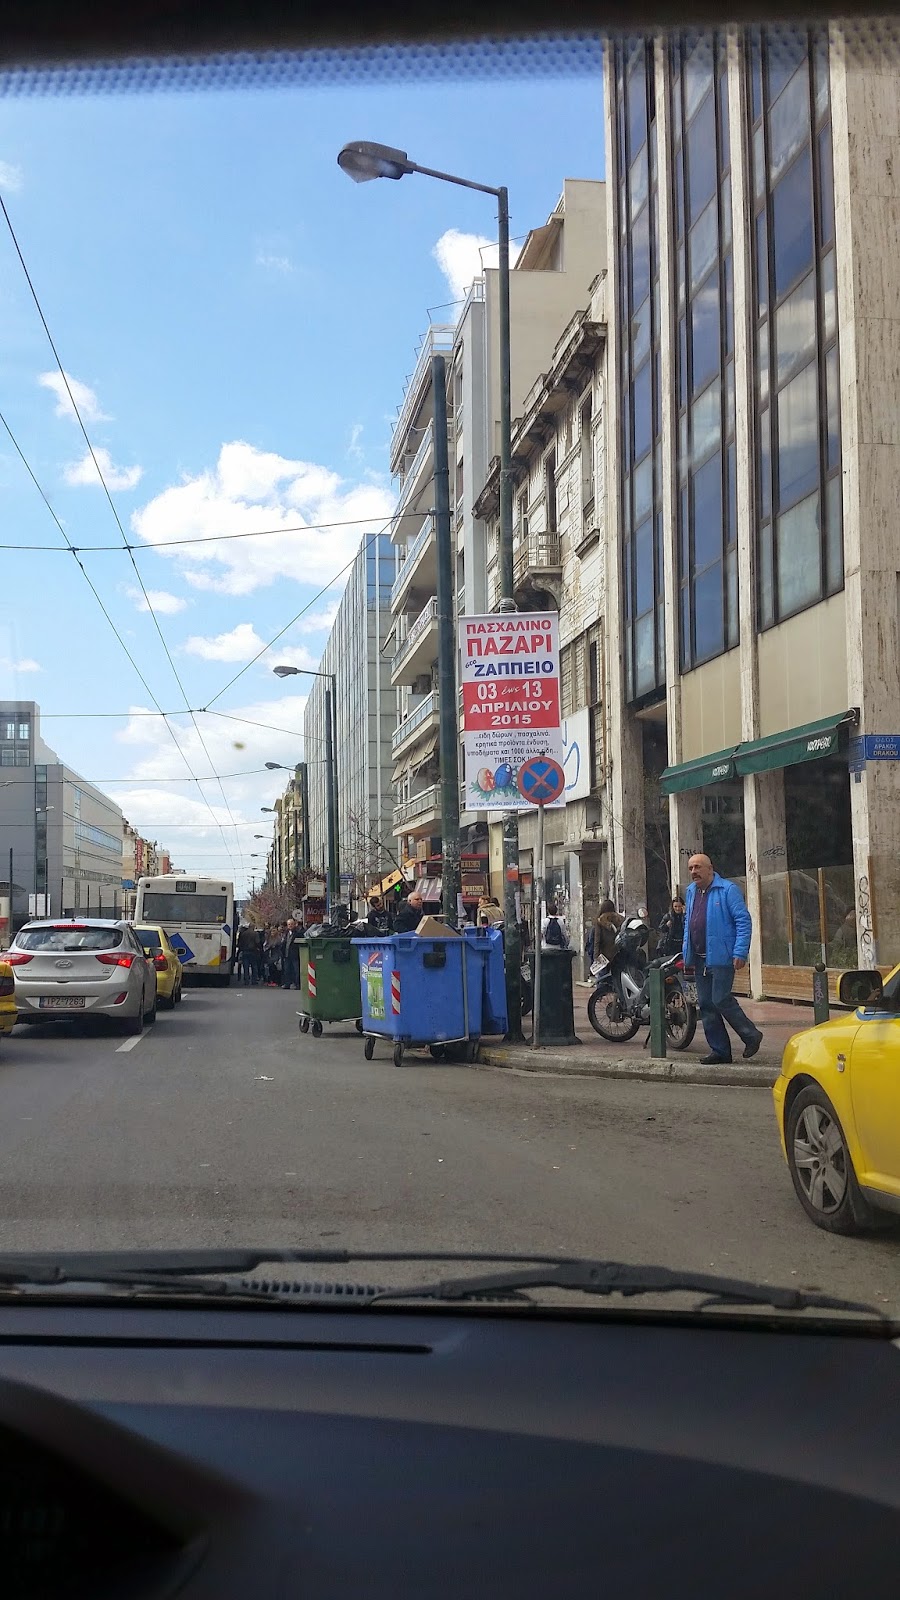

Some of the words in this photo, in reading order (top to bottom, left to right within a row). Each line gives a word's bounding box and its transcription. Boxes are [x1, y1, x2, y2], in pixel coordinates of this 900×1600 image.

[466, 620, 552, 634] ΠΑΣΧΑΛΙΝΟ
[467, 634, 552, 657] ΠΑΖΑΡΙ
[474, 660, 554, 677] ΖΑΠΠΕΙΟ
[477, 682, 498, 700] 03
[522, 681, 543, 698] 13
[469, 700, 553, 714] ΑΠΡΙΛΙΟΥ
[491, 714, 532, 726] 2015
